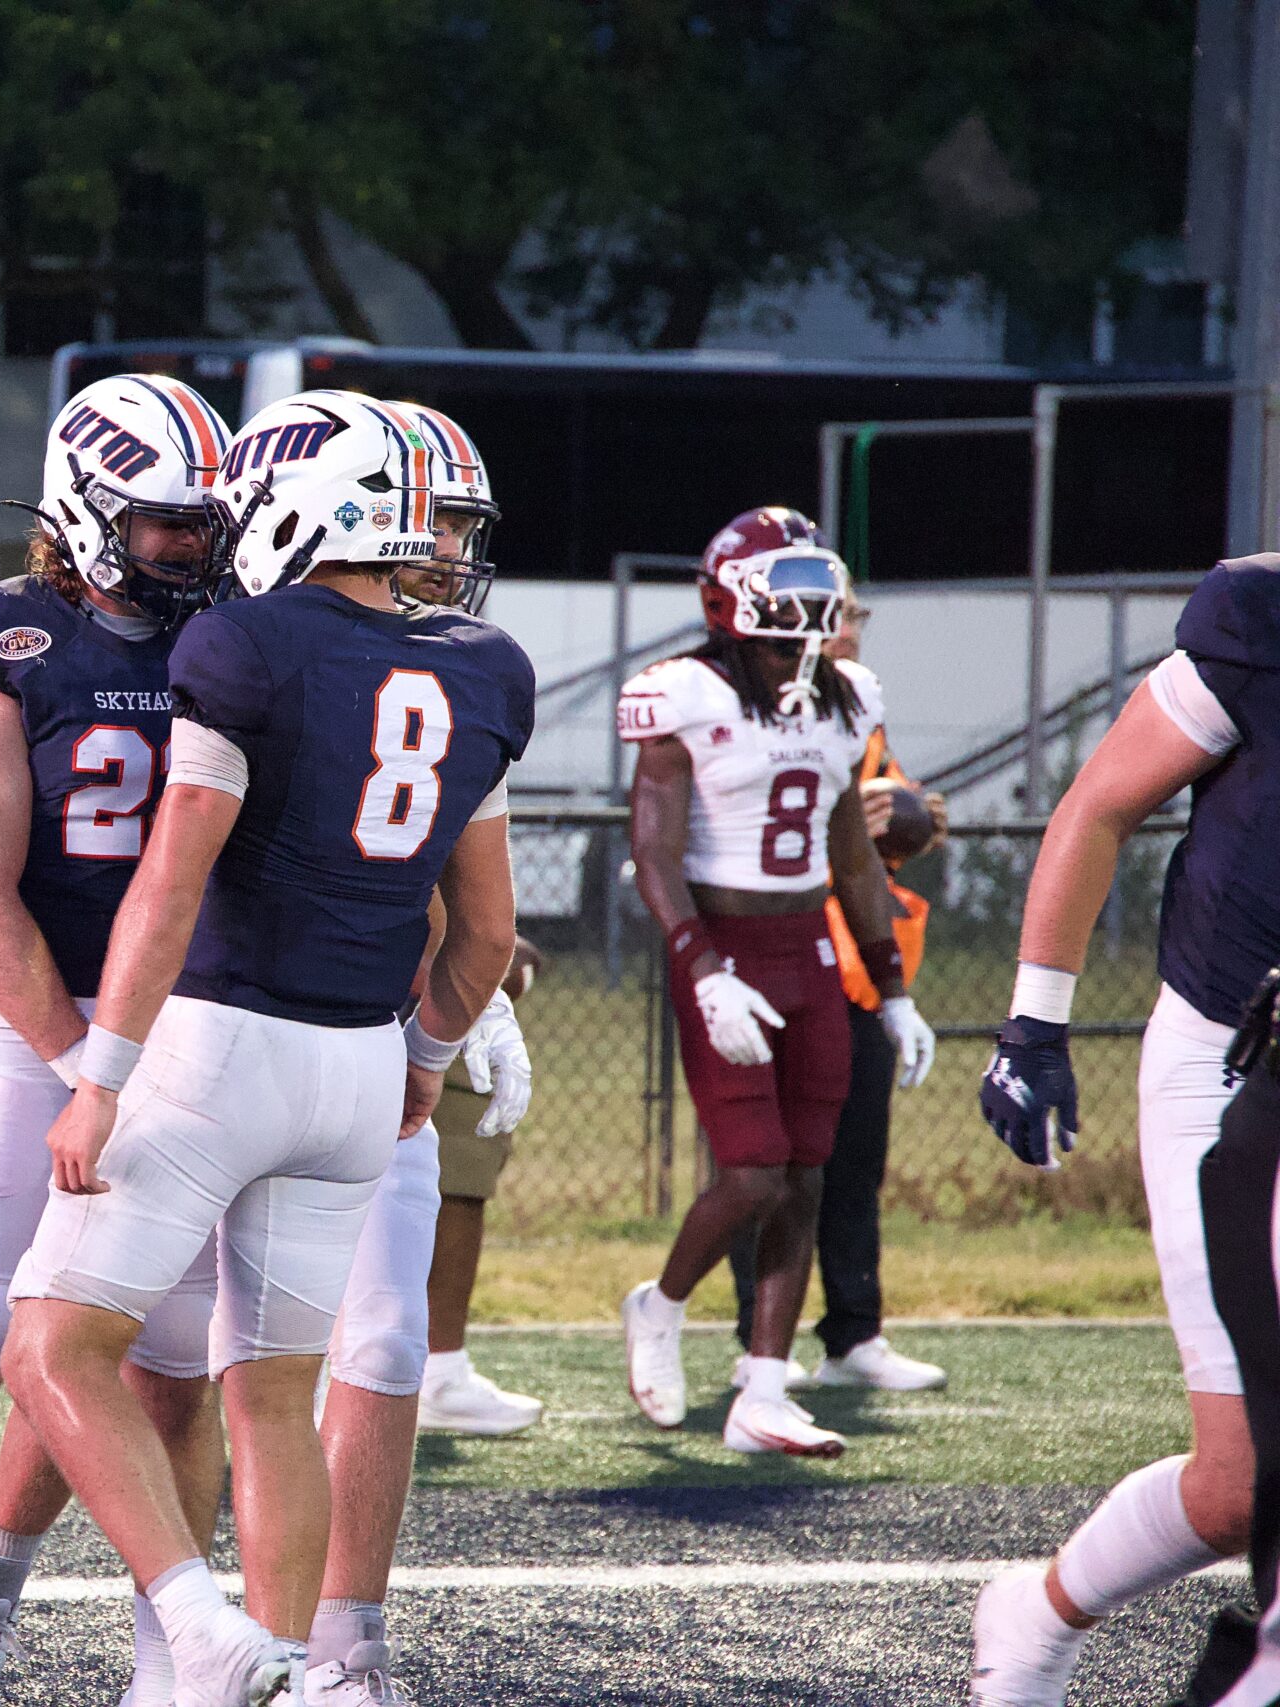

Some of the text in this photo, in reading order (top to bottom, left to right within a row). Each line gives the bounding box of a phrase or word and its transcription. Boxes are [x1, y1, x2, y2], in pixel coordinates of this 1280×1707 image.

[59, 405, 160, 483] UTM
[224, 420, 334, 486] UTM
[378, 541, 436, 556] SKYHAW
[8, 636, 36, 650] OVC
[62, 724, 171, 858] 2
[351, 668, 455, 862] 8
[761, 769, 820, 876] 8
